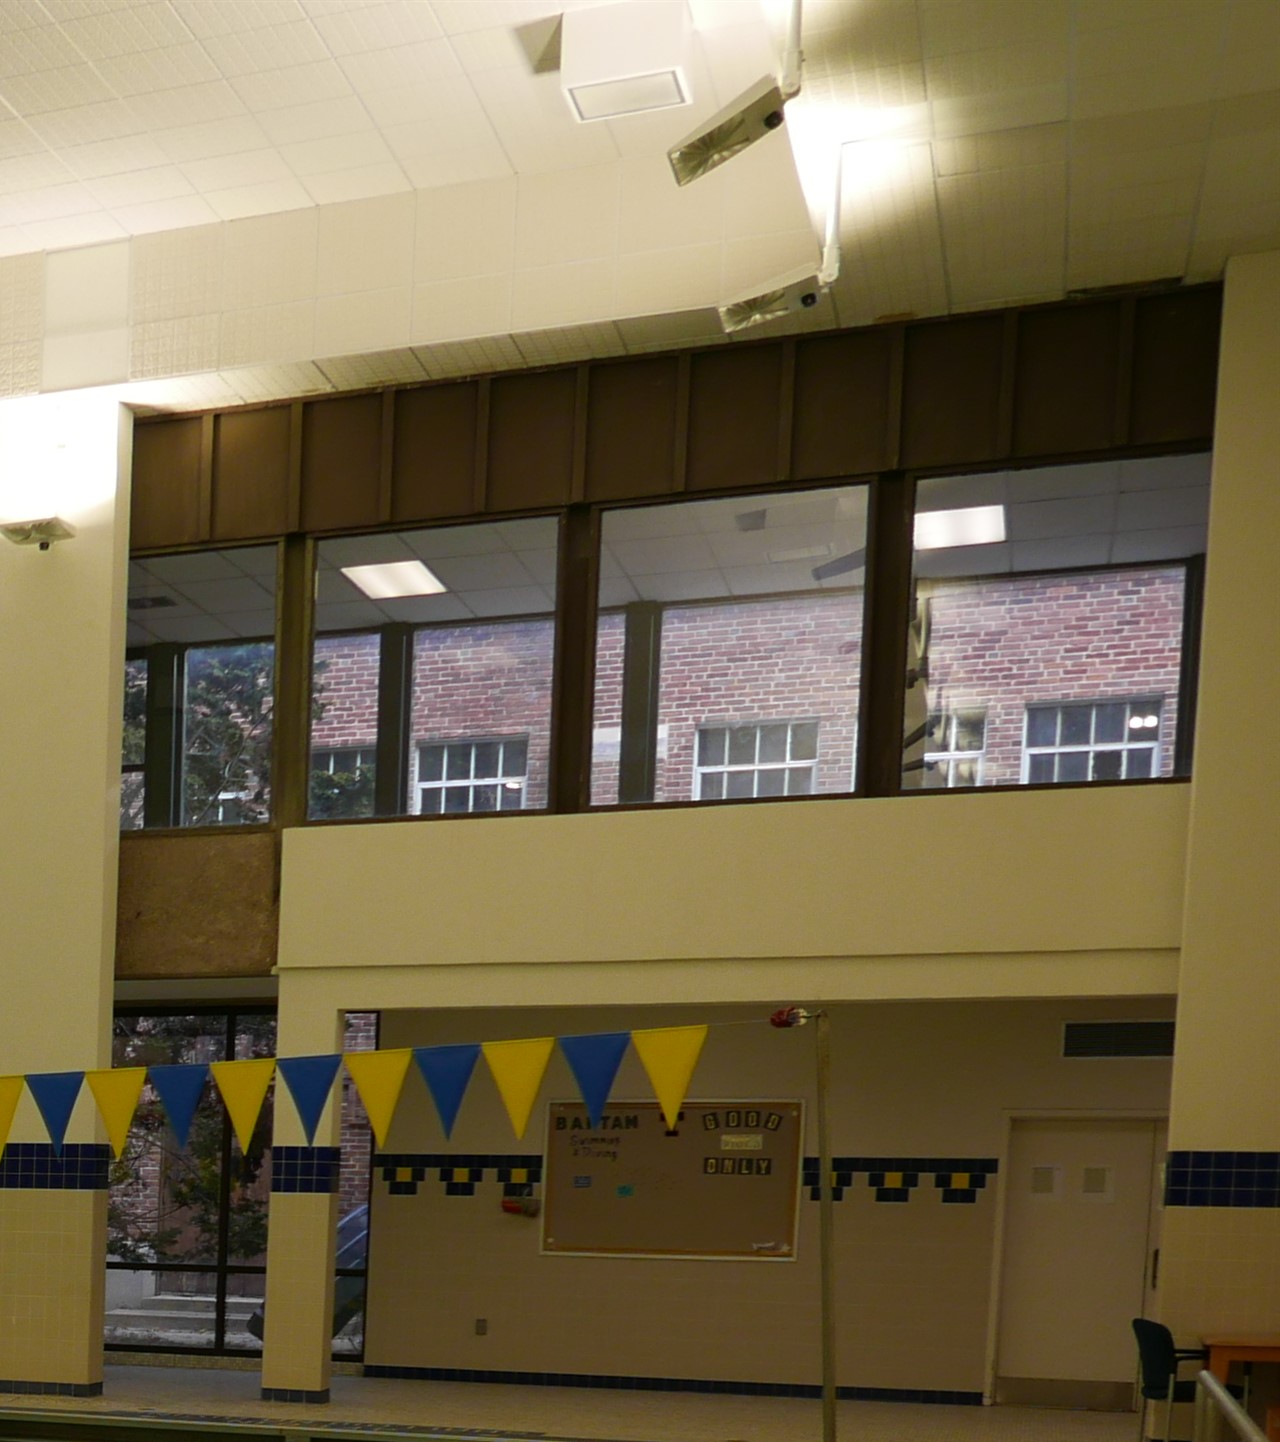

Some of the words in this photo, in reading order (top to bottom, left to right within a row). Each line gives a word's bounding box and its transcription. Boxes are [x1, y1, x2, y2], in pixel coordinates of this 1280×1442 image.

[556, 1116, 638, 1130] BATAM
[704, 1111, 781, 1130] GOOD
[706, 1159, 769, 1174] ONLY
